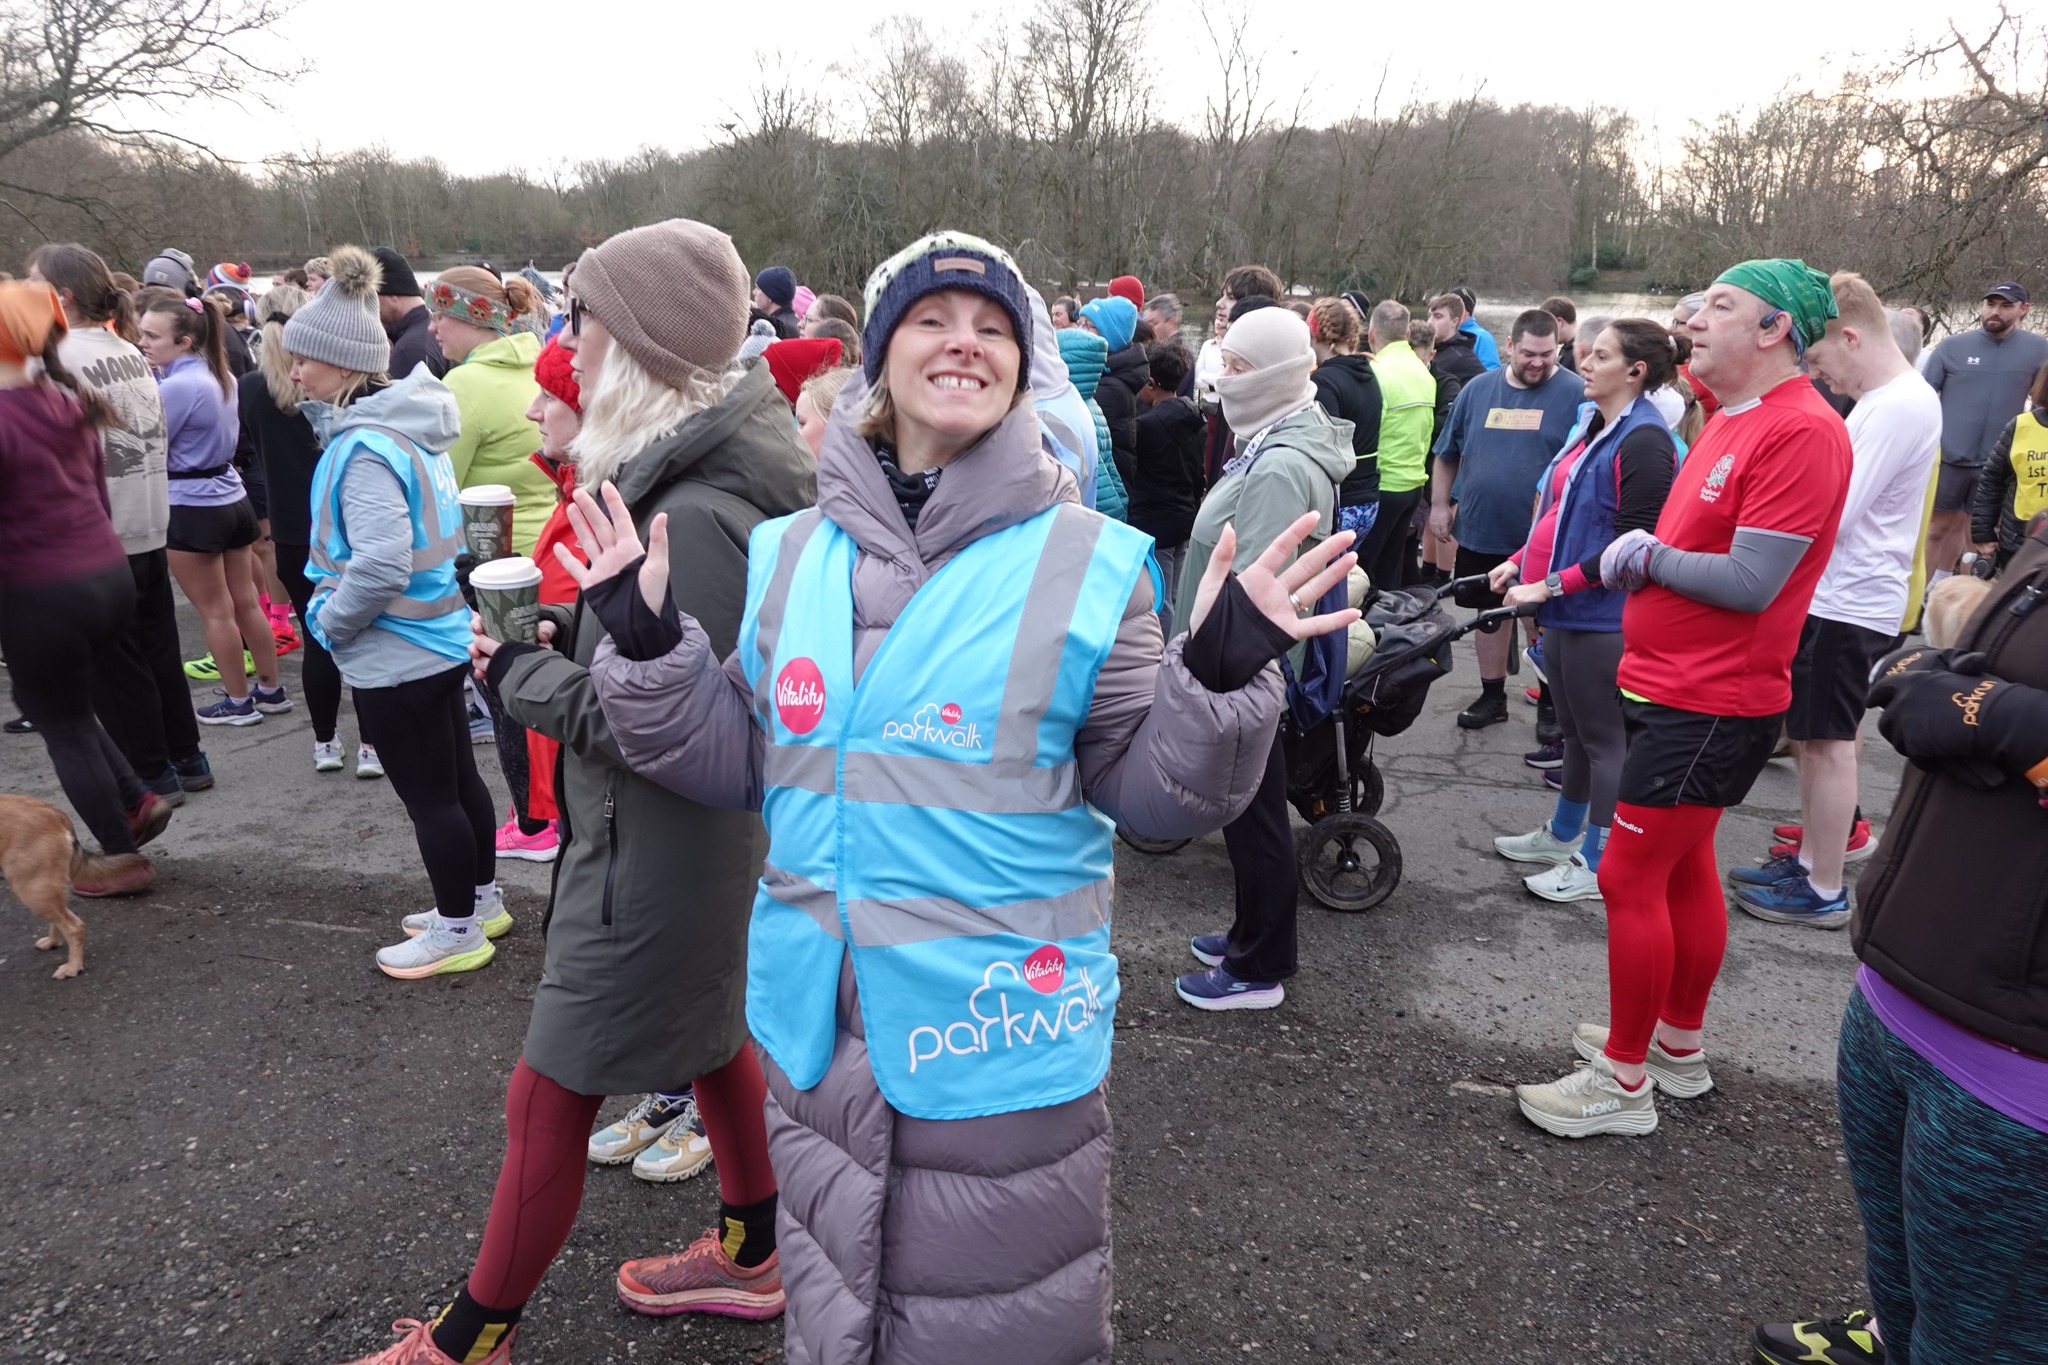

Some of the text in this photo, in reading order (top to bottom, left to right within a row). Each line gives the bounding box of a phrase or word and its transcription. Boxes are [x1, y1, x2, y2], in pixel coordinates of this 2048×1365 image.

[2028, 465, 2046, 478] 1st
[2037, 482, 2048, 498] T
[777, 676, 824, 715] Vitality
[882, 703, 982, 750] parkwalk
[1024, 957, 1064, 981] Vitality
[909, 961, 1103, 1074] parkwalk
[1582, 1098, 1622, 1118] HOKA
